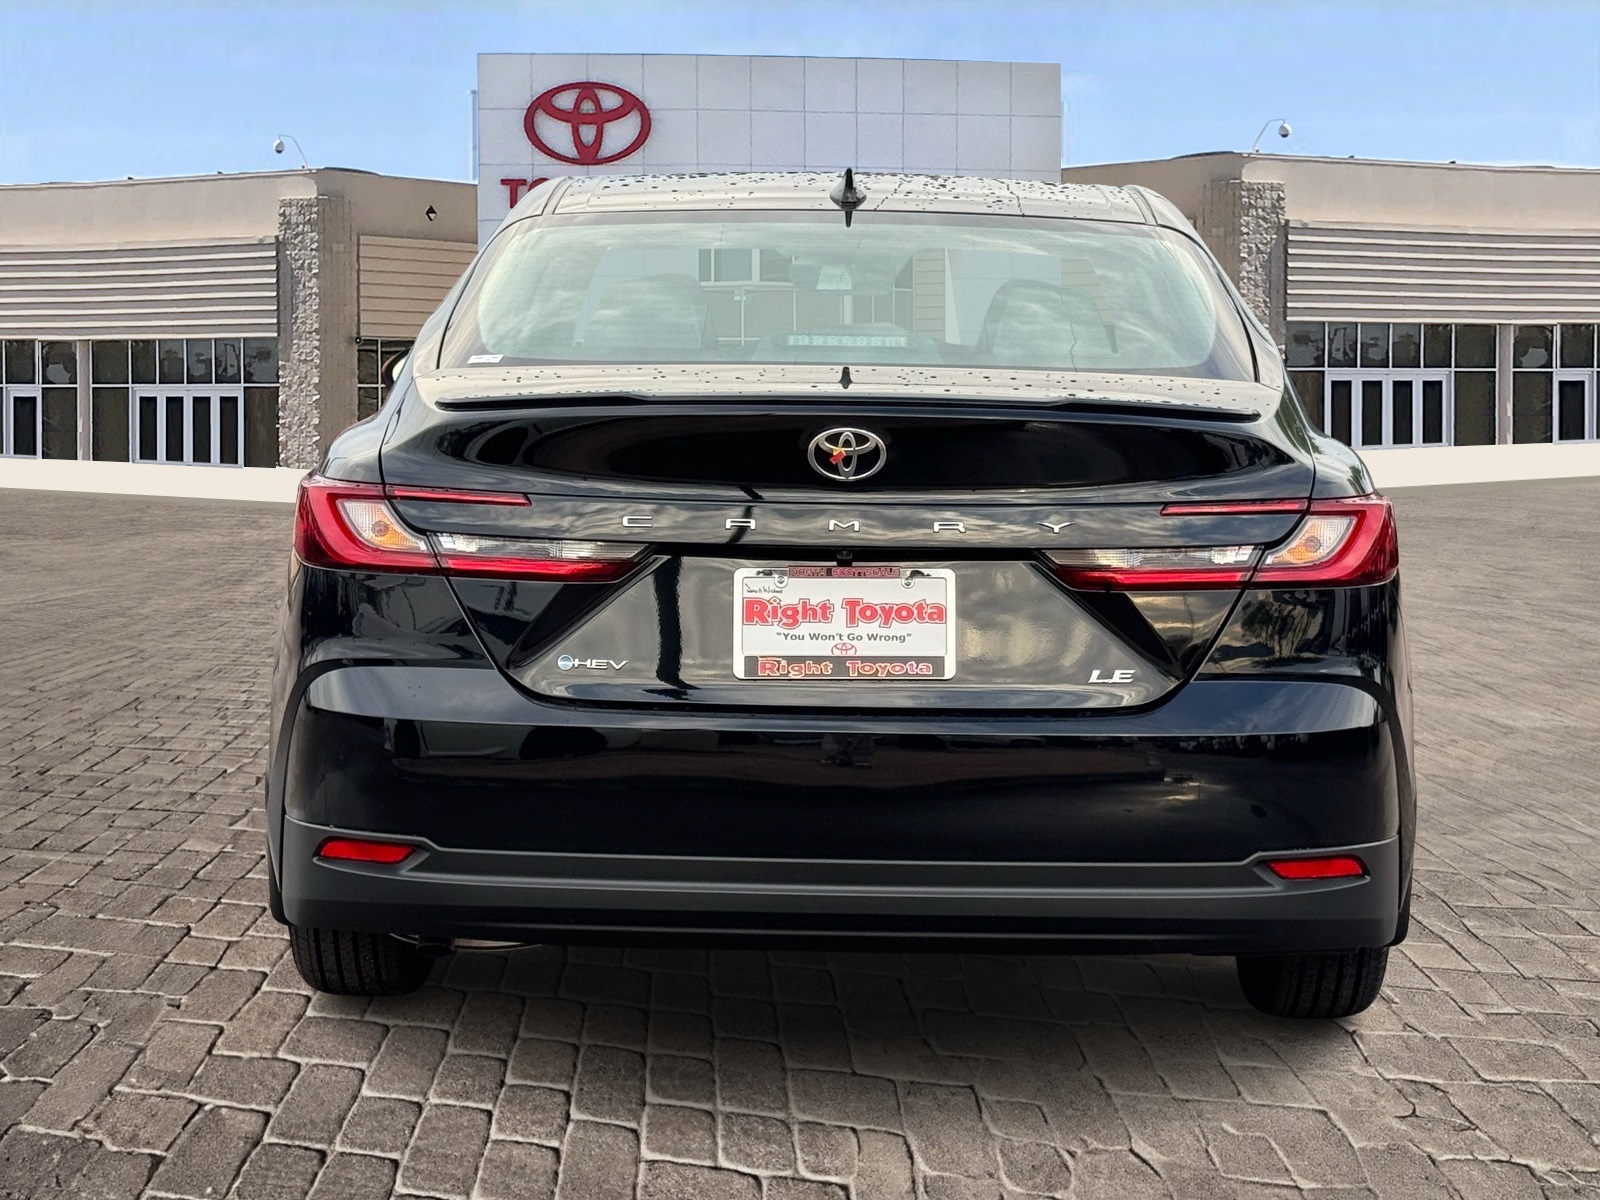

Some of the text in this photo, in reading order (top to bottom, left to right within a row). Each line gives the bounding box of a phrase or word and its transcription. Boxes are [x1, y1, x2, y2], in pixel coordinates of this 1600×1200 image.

[622, 515, 1076, 533] CAMRY
[743, 596, 947, 629] Right Toyota
[847, 633, 863, 642] Go
[574, 658, 629, 670] HEV
[758, 659, 933, 678] Right Toyota
[1088, 669, 1136, 684] LE
